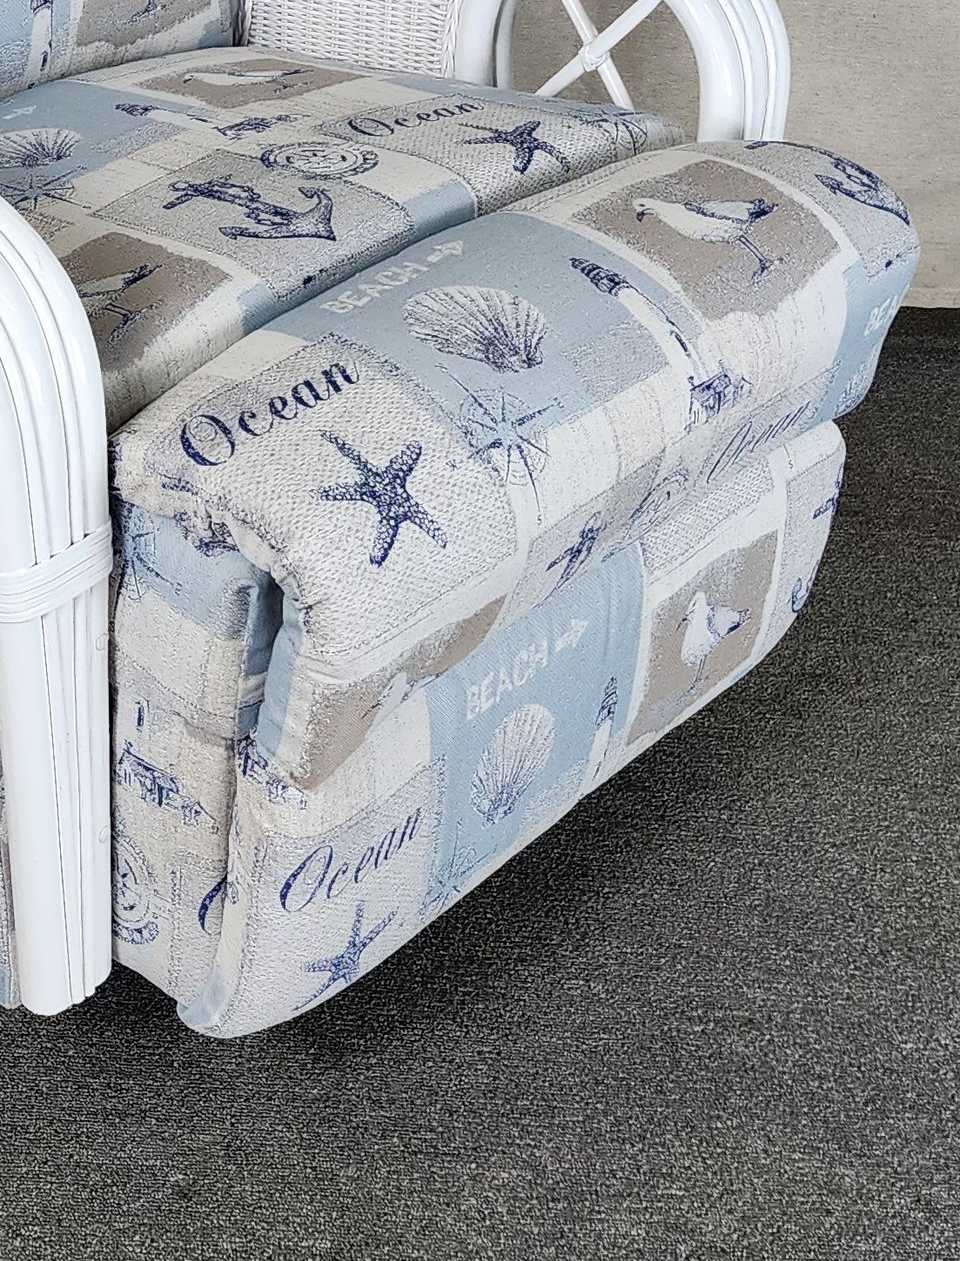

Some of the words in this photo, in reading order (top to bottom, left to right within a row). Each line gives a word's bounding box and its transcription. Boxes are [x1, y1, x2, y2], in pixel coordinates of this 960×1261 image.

[348, 102, 485, 137] Ocean
[320, 261, 430, 314] BEACH
[180, 361, 360, 467] Ocean
[466, 636, 548, 720] BEACH
[280, 806, 424, 913] Ocean
